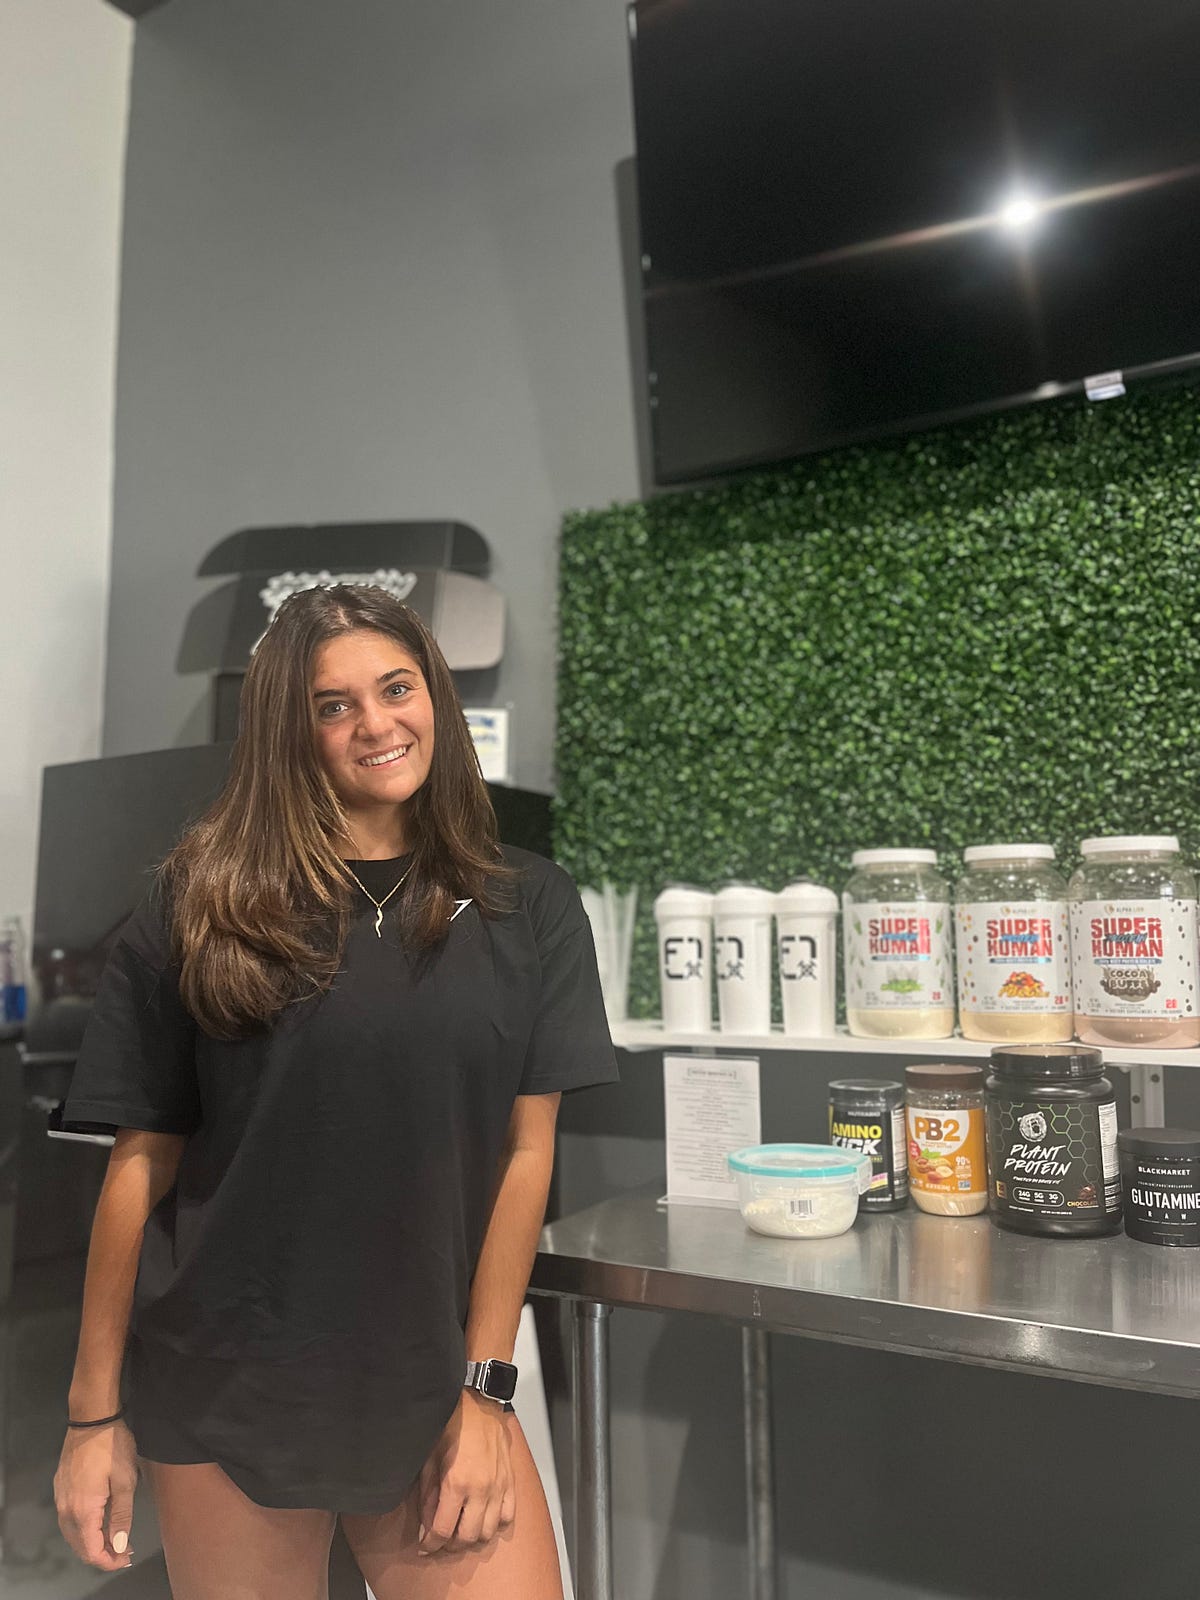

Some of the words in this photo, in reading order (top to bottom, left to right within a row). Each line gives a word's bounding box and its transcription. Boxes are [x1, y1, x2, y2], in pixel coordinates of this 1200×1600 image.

[868, 917, 930, 937] SUPER
[986, 918, 1052, 939] SUPER
[1091, 917, 1163, 939] SUPER
[869, 938, 931, 954] HUMAN
[987, 938, 1053, 956] HUMAN
[1091, 939, 1164, 958] HUMAN
[1110, 970, 1147, 978] COCOA
[832, 1122, 883, 1139] AMINO
[914, 1116, 961, 1142] PB2
[1010, 1144, 1067, 1160] PLANT
[1004, 1158, 1072, 1176] PROTEIN
[1138, 1166, 1191, 1176] BLACKMARKET
[1018, 1190, 1031, 1198] 24G
[1131, 1188, 1200, 1210] GLUTAMINE
